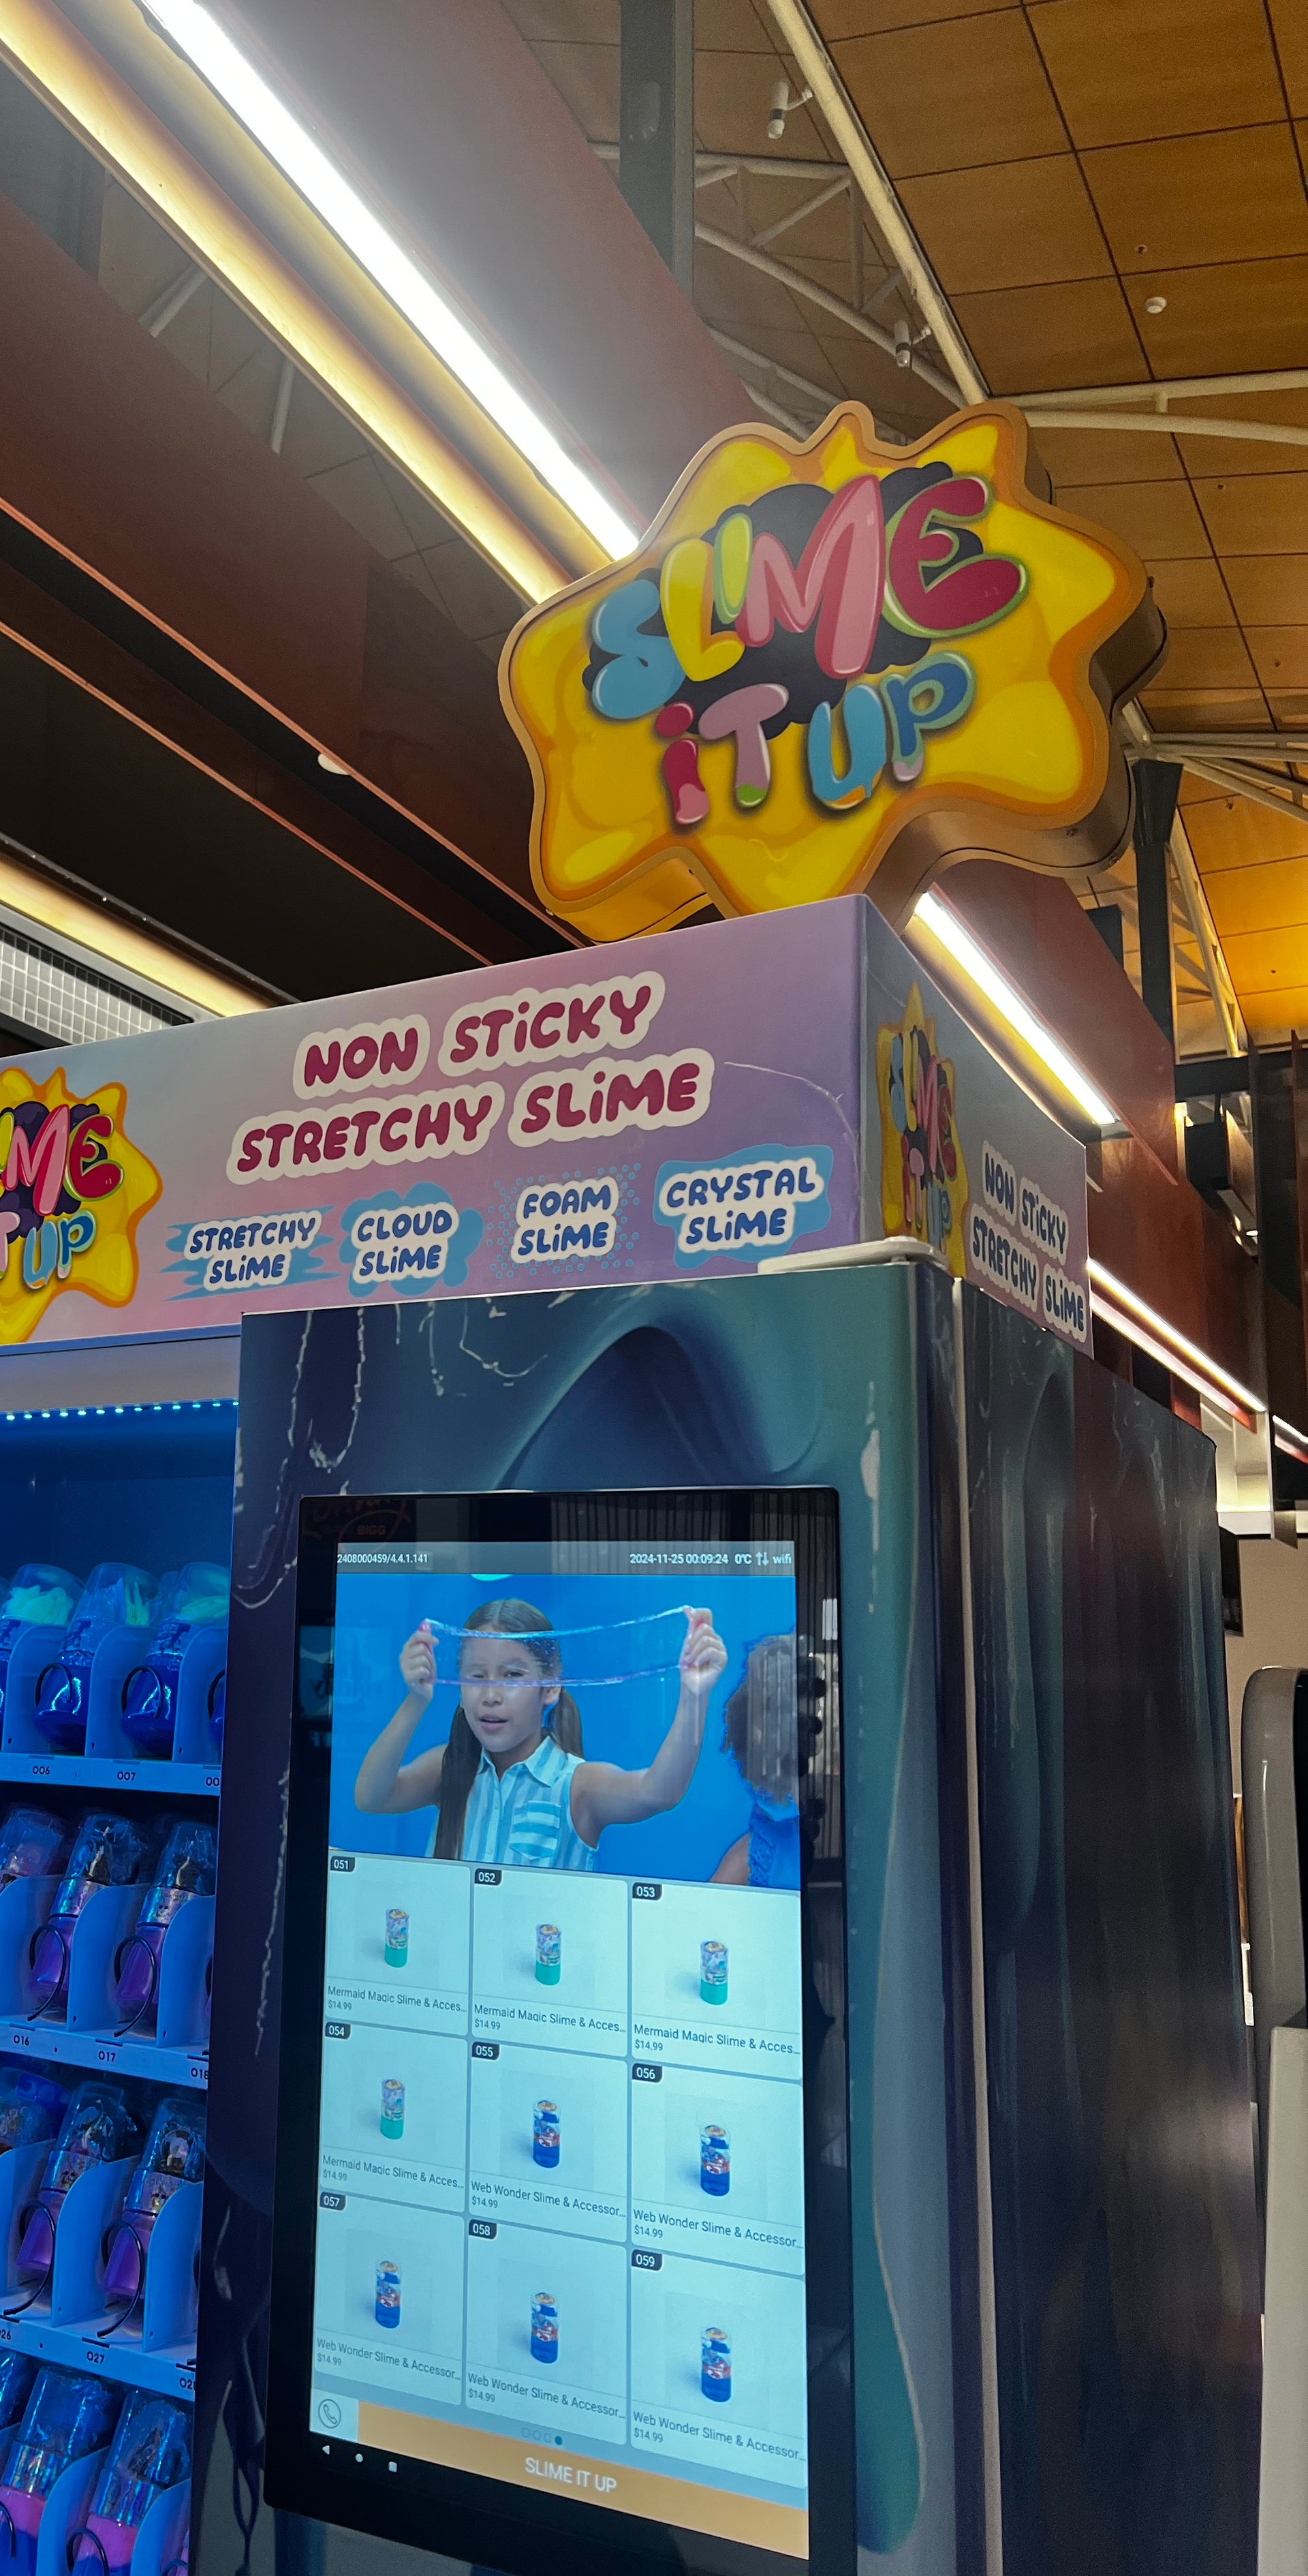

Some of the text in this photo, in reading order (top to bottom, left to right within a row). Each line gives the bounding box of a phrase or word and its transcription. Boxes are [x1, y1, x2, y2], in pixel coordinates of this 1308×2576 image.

[591, 474, 1029, 720] SLIME
[808, 651, 976, 810] UP
[303, 1027, 418, 1087] NON
[236, 1094, 493, 1173] STRETCHY
[666, 1165, 815, 1208] CRYSTAL
[985, 1152, 1014, 1214] NON
[523, 1184, 611, 1219] FOAM
[356, 1209, 453, 1242] CLOUD
[189, 1217, 317, 1254] STRETCHY
[23, 1210, 96, 1289] UP
[973, 1216, 1036, 1301] STRETCHY
[337, 1553, 428, 1564] 2408000459/4.4.1.141
[629, 1553, 684, 1565] 2024-11-25
[685, 1553, 729, 1565] 00:09:24
[773, 1552, 792, 1565] wifi
[32, 1765, 50, 1775] 006
[116, 1772, 136, 1782] 007
[206, 1777, 220, 1786] 00
[334, 1858, 349, 1870] 051
[478, 1871, 496, 1884] 052
[636, 1886, 655, 1898] 053
[328, 1985, 365, 2000] Mermaid
[368, 1991, 394, 2004] Magic
[397, 1994, 422, 2006] Slime
[424, 1997, 431, 2008] &
[328, 1999, 352, 2010] $14.99
[474, 2004, 515, 2019] Mermaid
[518, 2009, 547, 2023] Magic
[550, 2013, 576, 2027] Slime
[579, 2018, 586, 2027] &
[328, 2025, 345, 2036] 054
[474, 2019, 501, 2030] $14.99
[13, 2034, 30, 2046] 016
[634, 2024, 679, 2040] Mermaid
[682, 2030, 713, 2044] Magic
[716, 2034, 746, 2048] Slime
[749, 2038, 756, 2049] &
[476, 2045, 493, 2057] 055
[634, 2039, 663, 2051] $14.99
[98, 2051, 116, 2063] 017
[636, 2067, 655, 2080] 056
[323, 2155, 361, 2171] Mermaid
[363, 2162, 390, 2176] Magic
[392, 2167, 418, 2181] Slime
[420, 2171, 426, 2182] &
[323, 2170, 347, 2181] $14.99
[471, 2180, 492, 2194] Web
[494, 2184, 531, 2201] Wonder
[533, 2192, 561, 2206] Slime
[563, 2196, 570, 2207] &
[324, 2195, 340, 2208] 057
[471, 2196, 498, 2209] $14.99
[473, 2223, 490, 2236] 058
[634, 2208, 656, 2223] Web
[658, 2213, 699, 2230] Wonder
[702, 2220, 732, 2237] Slime
[734, 2226, 742, 2238] &
[634, 2225, 663, 2238] $14.99
[636, 2254, 655, 2267] 059
[0, 2329, 12, 2340] 26
[87, 2350, 105, 2365] 027
[317, 2337, 336, 2351] Web
[339, 2342, 373, 2360] Wonder
[375, 2351, 400, 2366] Slime
[403, 2357, 409, 2368] &
[317, 2353, 342, 2366] $14.99
[179, 2377, 196, 2391] 02
[467, 2372, 489, 2387] Web
[491, 2377, 528, 2395] Wonder
[531, 2387, 559, 2404] Slime
[561, 2393, 569, 2406] &
[468, 2389, 495, 2403] $14.99
[633, 2410, 656, 2426] Web
[659, 2417, 700, 2436] Wonder
[702, 2427, 732, 2444] Slime
[736, 2434, 744, 2447] &
[634, 2427, 664, 2443] $14.99
[525, 2457, 617, 2493] SLIME IT UP
